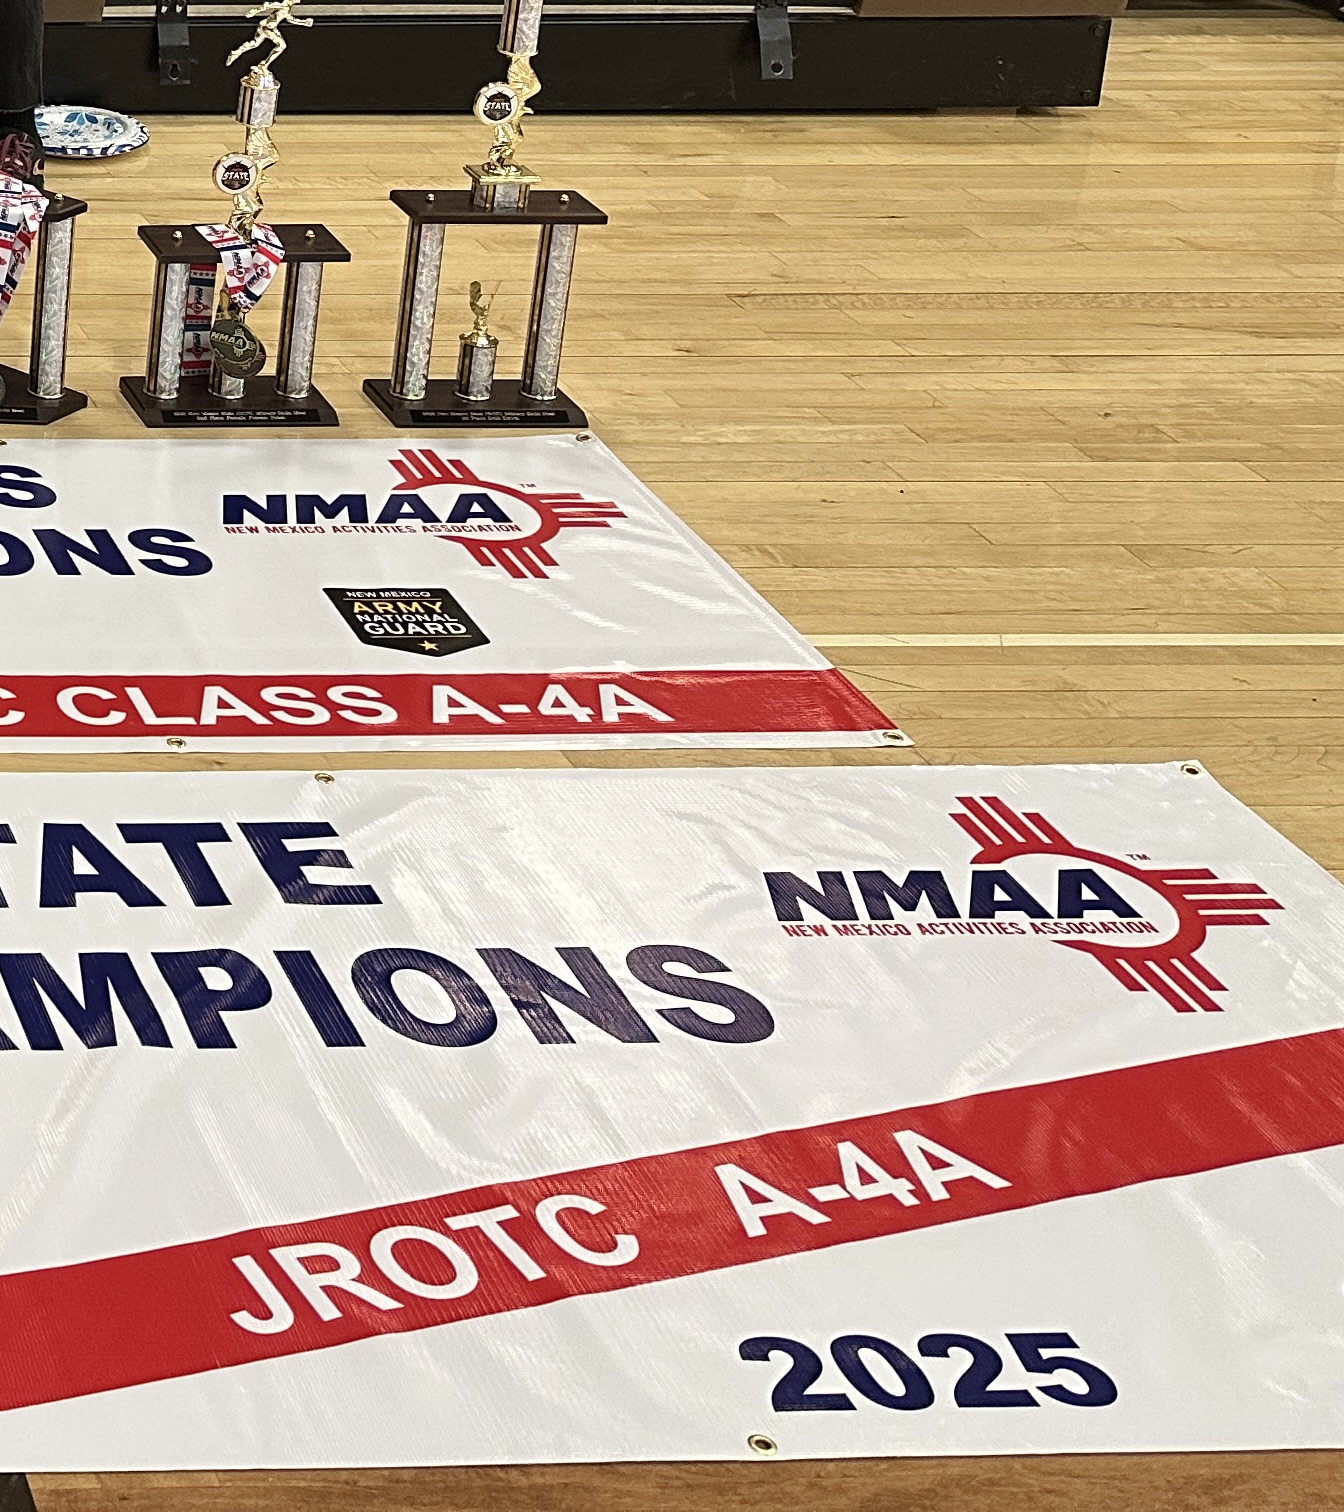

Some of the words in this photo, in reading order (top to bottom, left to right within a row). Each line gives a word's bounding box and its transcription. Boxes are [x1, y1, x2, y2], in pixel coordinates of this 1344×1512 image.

[484, 102, 511, 110] STATE
[222, 172, 249, 180] STATE
[223, 492, 516, 525] NMAA
[225, 525, 260, 536] NEW
[264, 525, 326, 536] MEXICO
[331, 524, 416, 535] ACTIVITIES
[421, 523, 521, 534] ASSOCIATION
[346, 590, 376, 599] NEW
[379, 590, 431, 599] MEXICO
[352, 599, 443, 614] ARMY
[355, 611, 461, 624] NATIONAL
[363, 620, 467, 637] GUARD
[57, 684, 402, 729] CLASS
[432, 683, 675, 724] A-4A
[763, 869, 1143, 923] NMAA
[782, 924, 829, 938] NEW
[834, 922, 910, 938] MEXICO
[917, 920, 1025, 936] ACTIVITIES
[1030, 918, 1159, 935] ASSOCIATION
[229, 1194, 640, 1337] JROTC
[713, 1129, 1012, 1240] A-4A
[738, 1332, 1118, 1414] 2025
